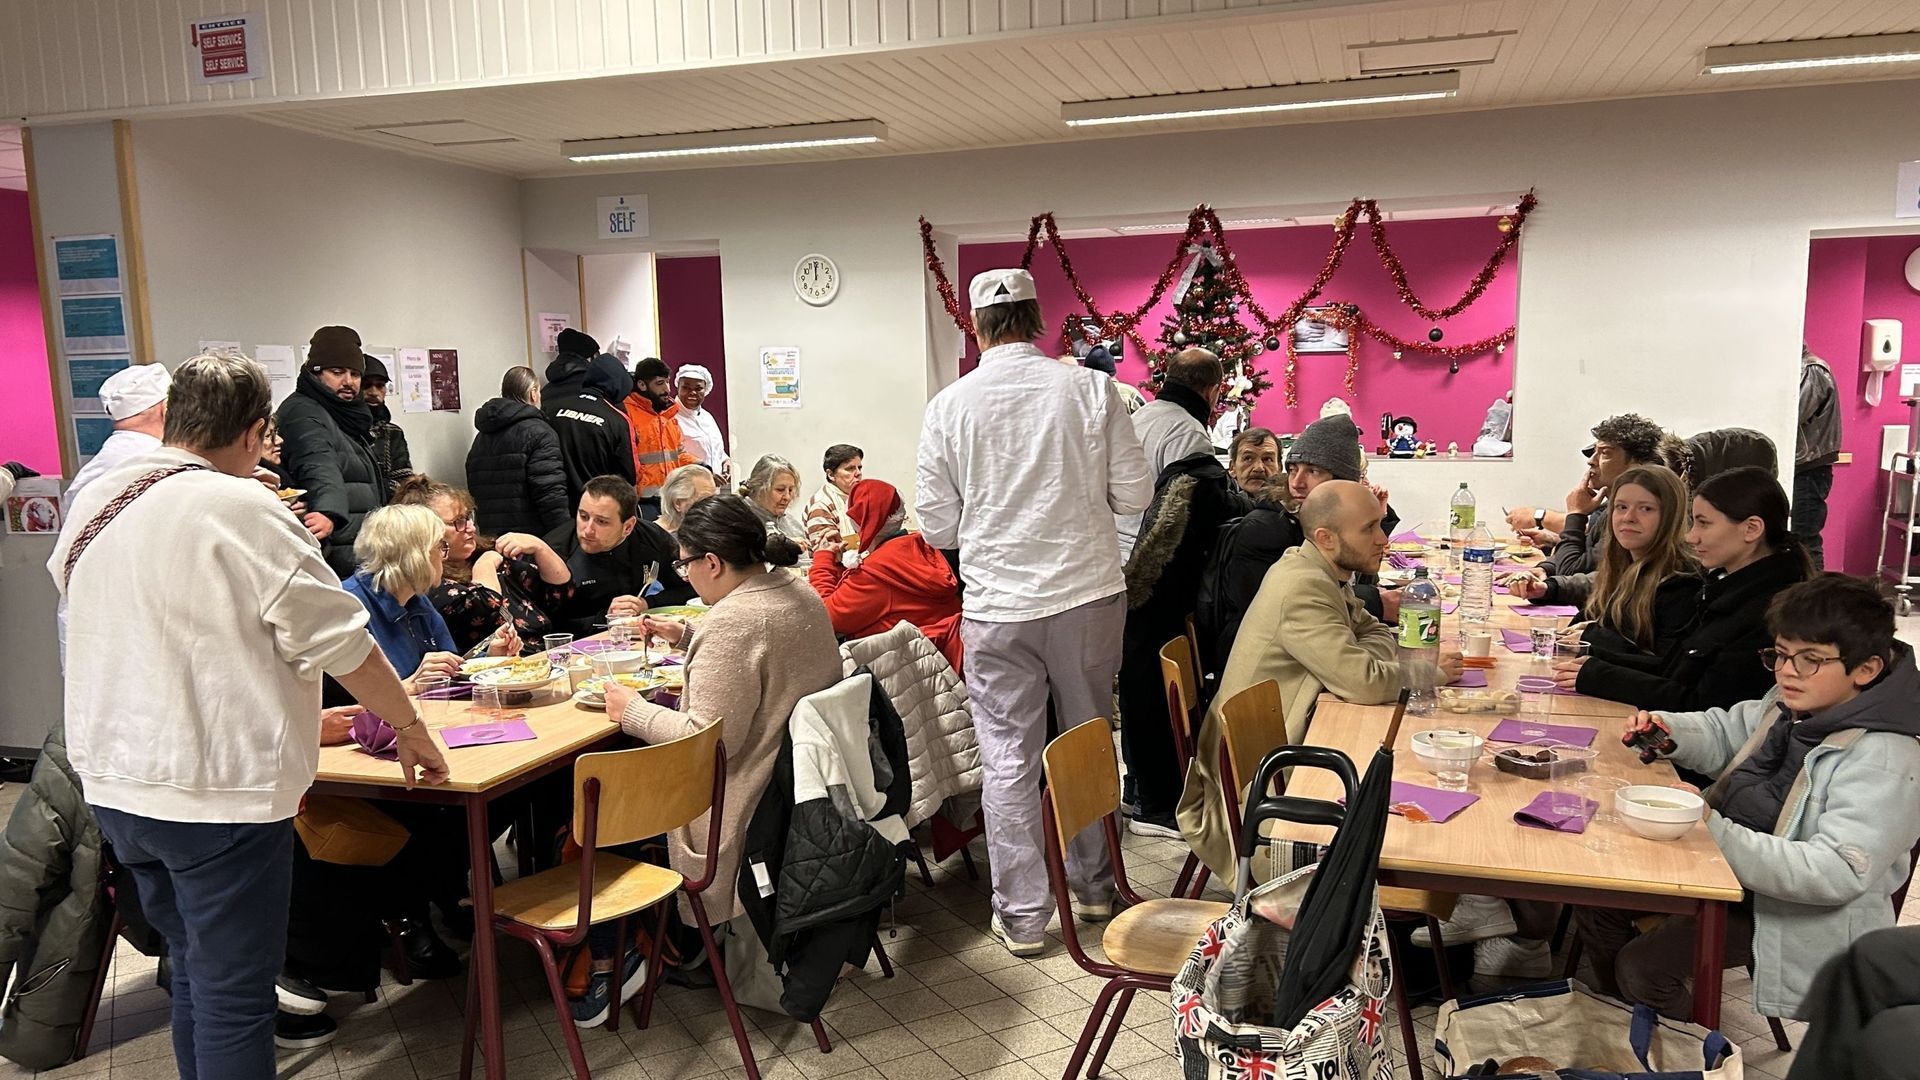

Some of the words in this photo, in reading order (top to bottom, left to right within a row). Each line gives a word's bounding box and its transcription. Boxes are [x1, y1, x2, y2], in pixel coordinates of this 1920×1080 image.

[202, 36, 217, 49] SELF
[217, 33, 243, 47] SERVICE
[205, 59, 219, 71] SELF
[219, 56, 245, 70] SERVICE
[609, 211, 636, 233] SELF
